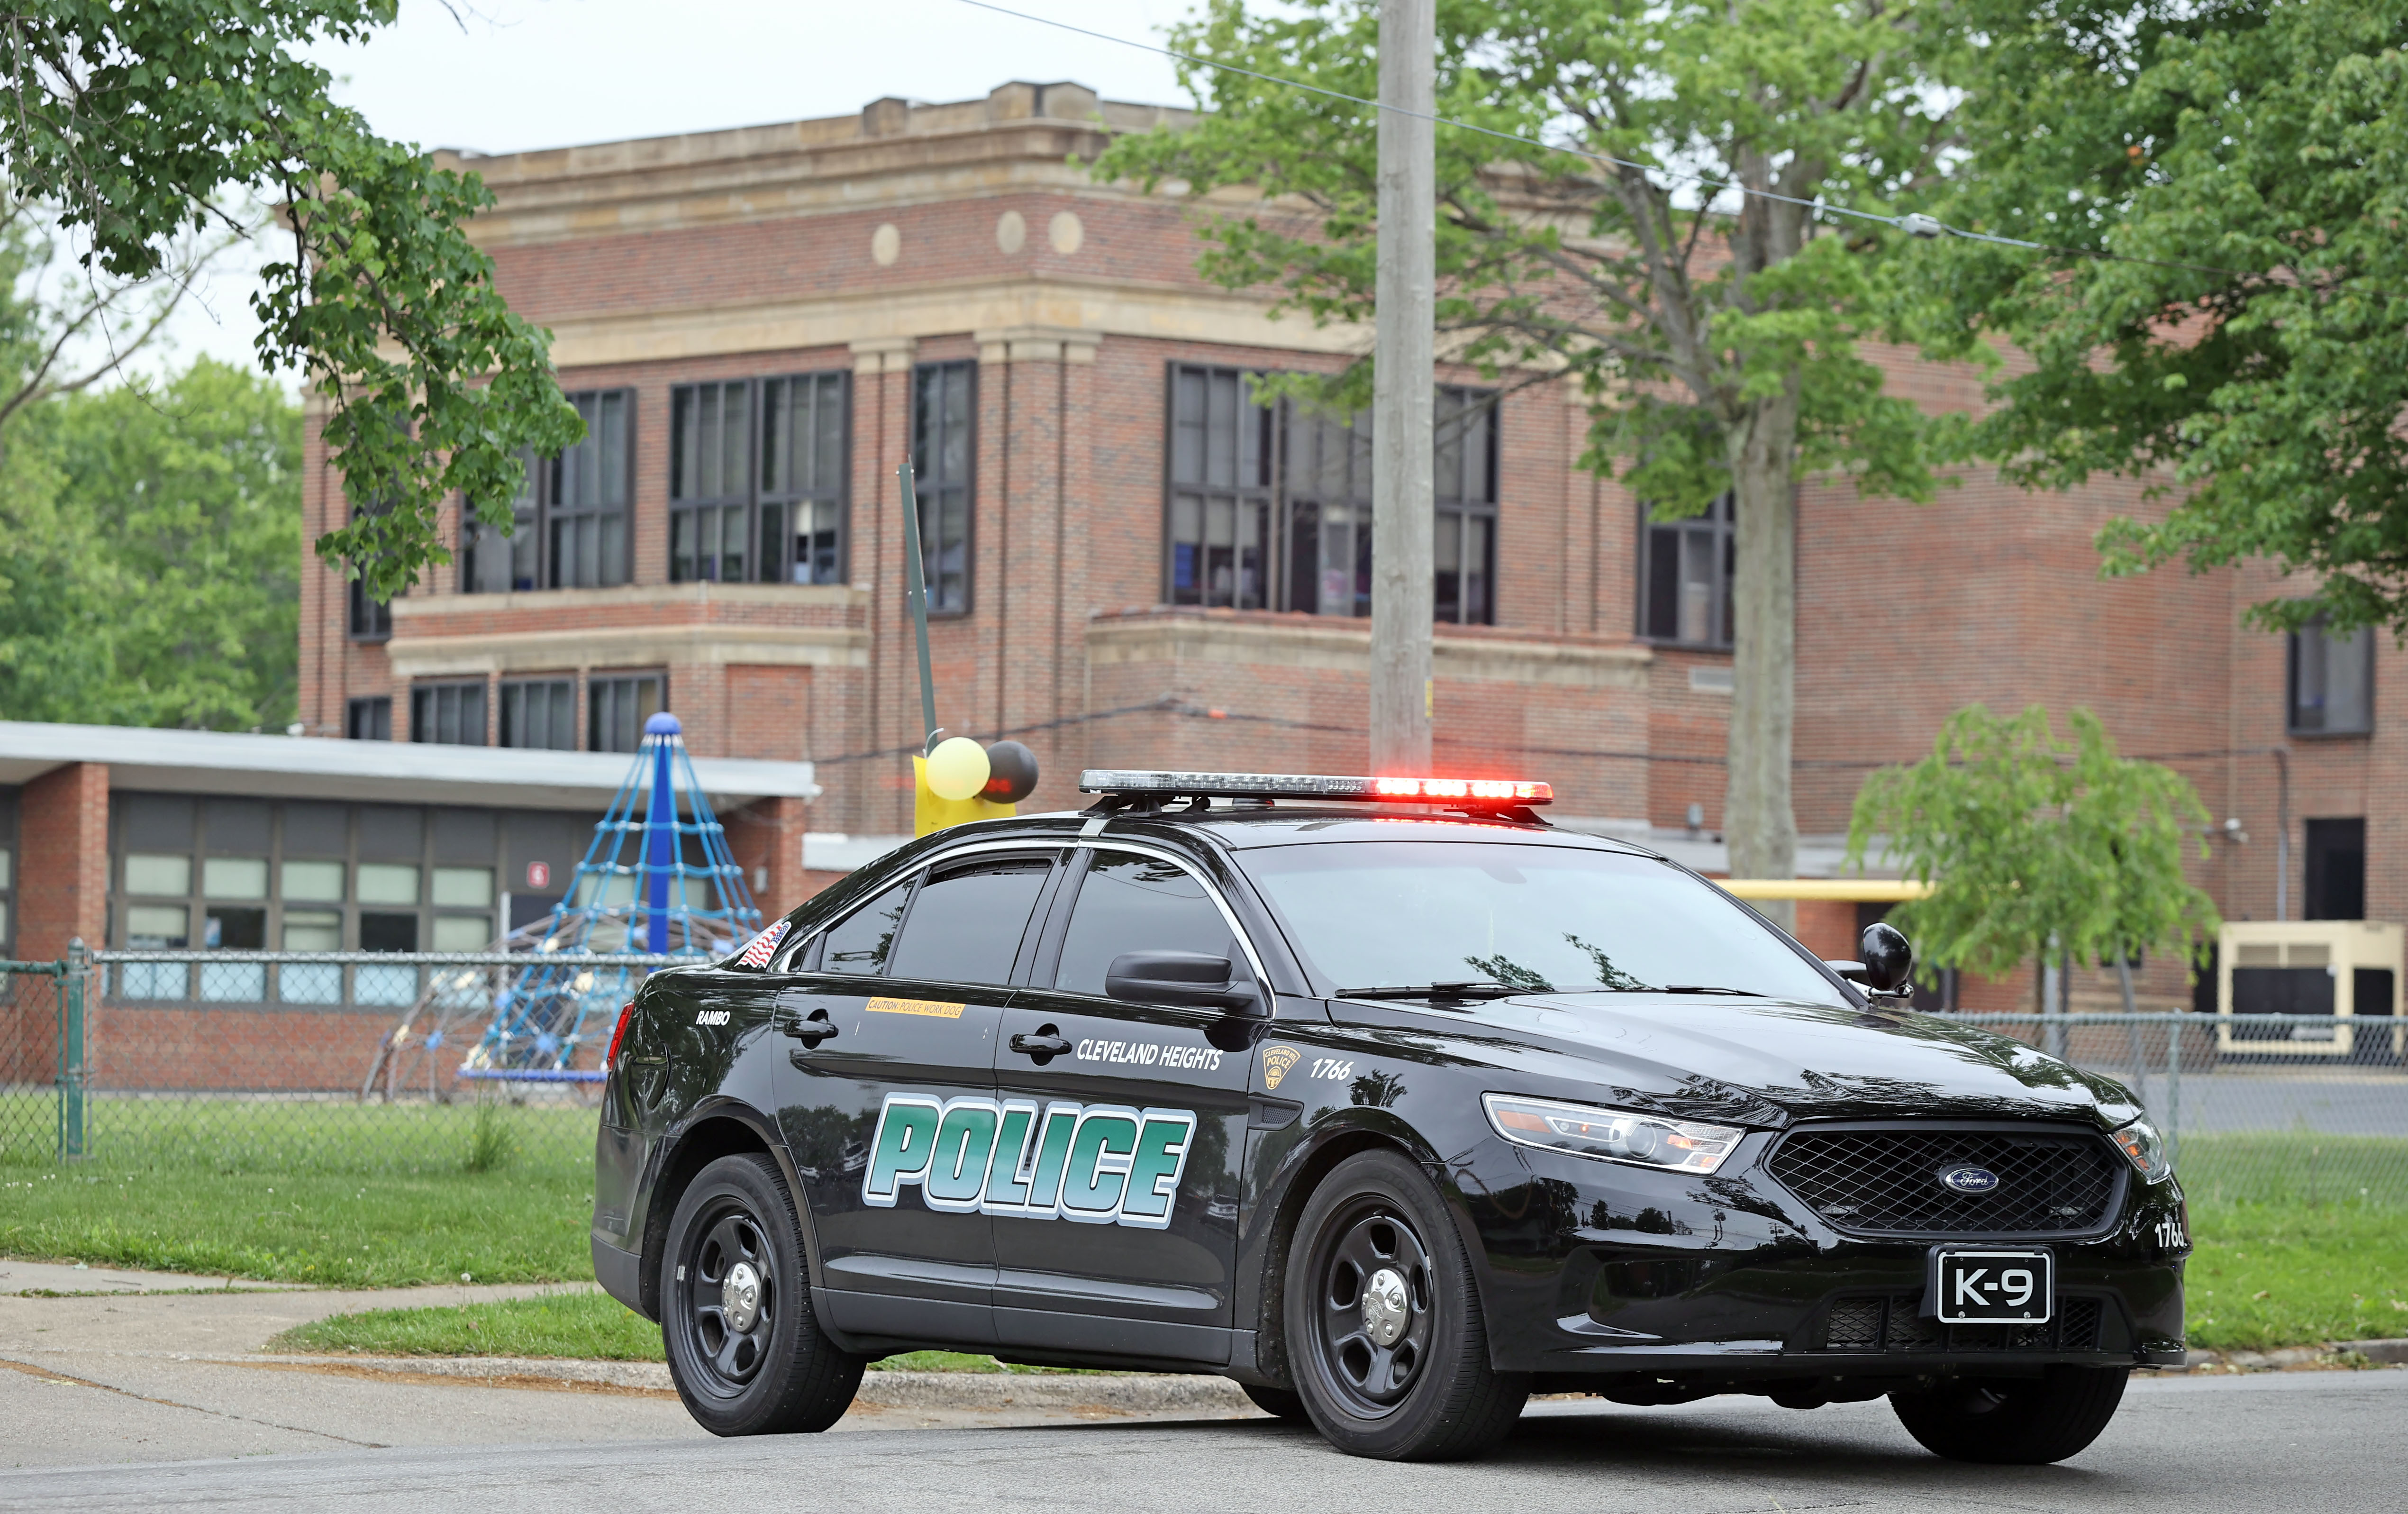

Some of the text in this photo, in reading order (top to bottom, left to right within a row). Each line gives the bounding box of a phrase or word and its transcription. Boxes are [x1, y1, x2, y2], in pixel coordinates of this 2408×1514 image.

[868, 999, 961, 1015] CAUTION: POLICE WORK DOG
[695, 1010, 730, 1026] RAMBO
[1077, 1039, 1224, 1071] CLEVELAND HEIGHTS
[1265, 1049, 1290, 1058] CLEVELAND
[1266, 1056, 1291, 1069] POLICE
[1310, 1058, 1354, 1080] 1766
[864, 1097, 1193, 1224] POLICE
[1960, 1172, 1989, 1186] Ford
[2154, 1222, 2184, 1248] 1766
[1955, 1268, 2033, 1306] K-9
